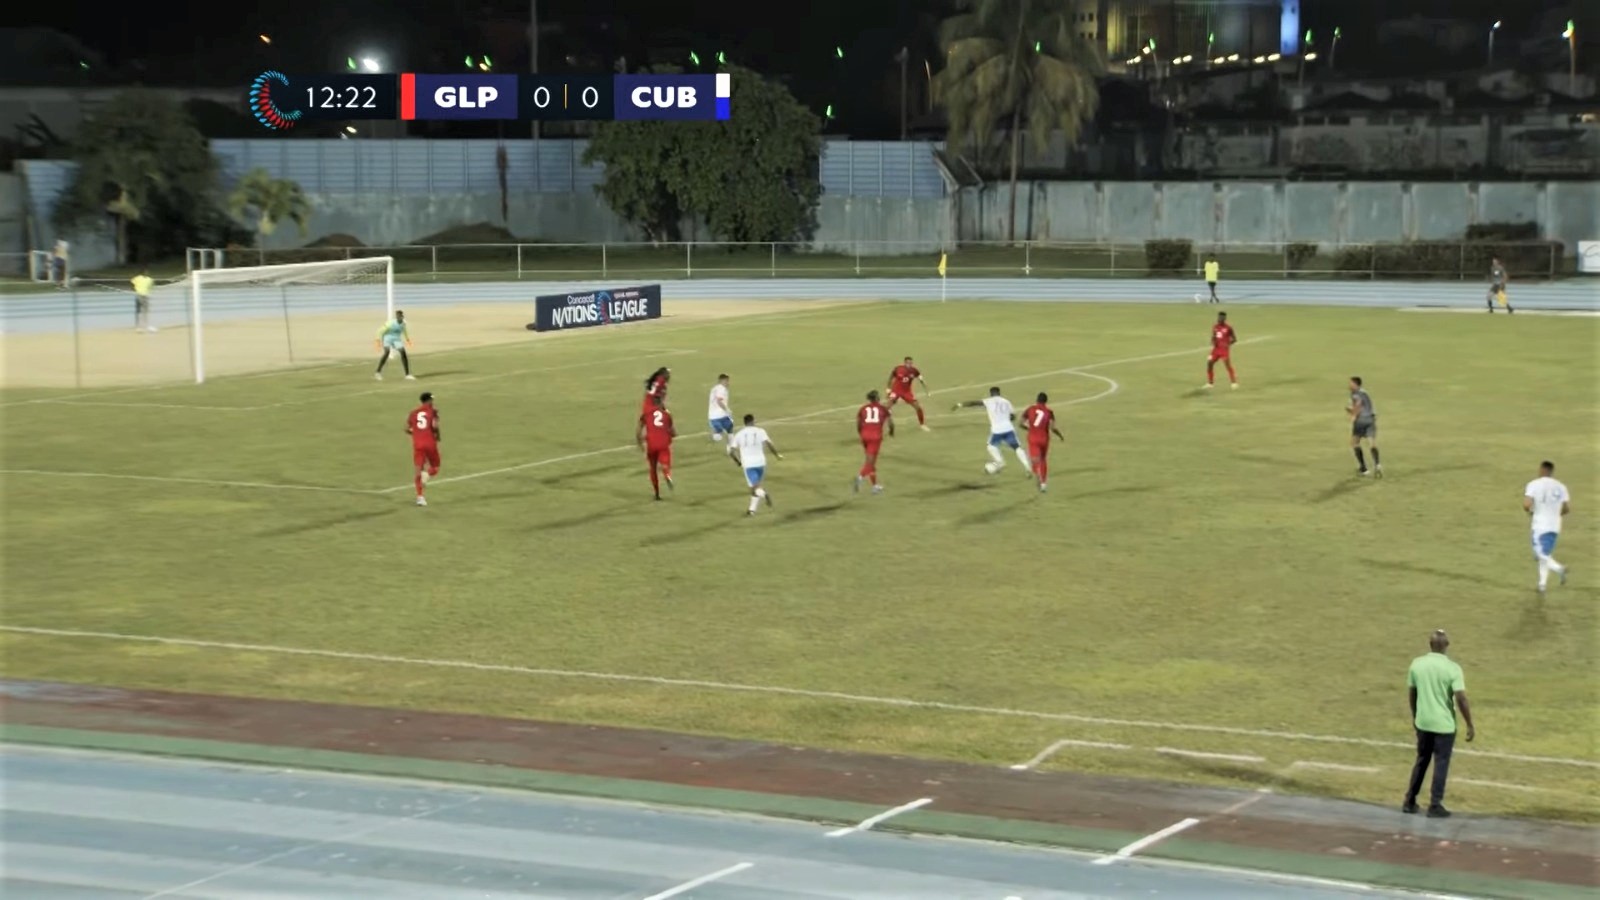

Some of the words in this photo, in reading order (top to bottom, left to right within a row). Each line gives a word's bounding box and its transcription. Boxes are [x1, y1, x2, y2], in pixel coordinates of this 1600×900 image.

[566, 293, 595, 305] Concacaf
[552, 303, 598, 327] NATIONS
[608, 298, 648, 320] LEAGUE
[416, 411, 428, 430] 5
[652, 410, 664, 427] 2
[864, 406, 880, 423] 11
[1033, 409, 1045, 427] 7
